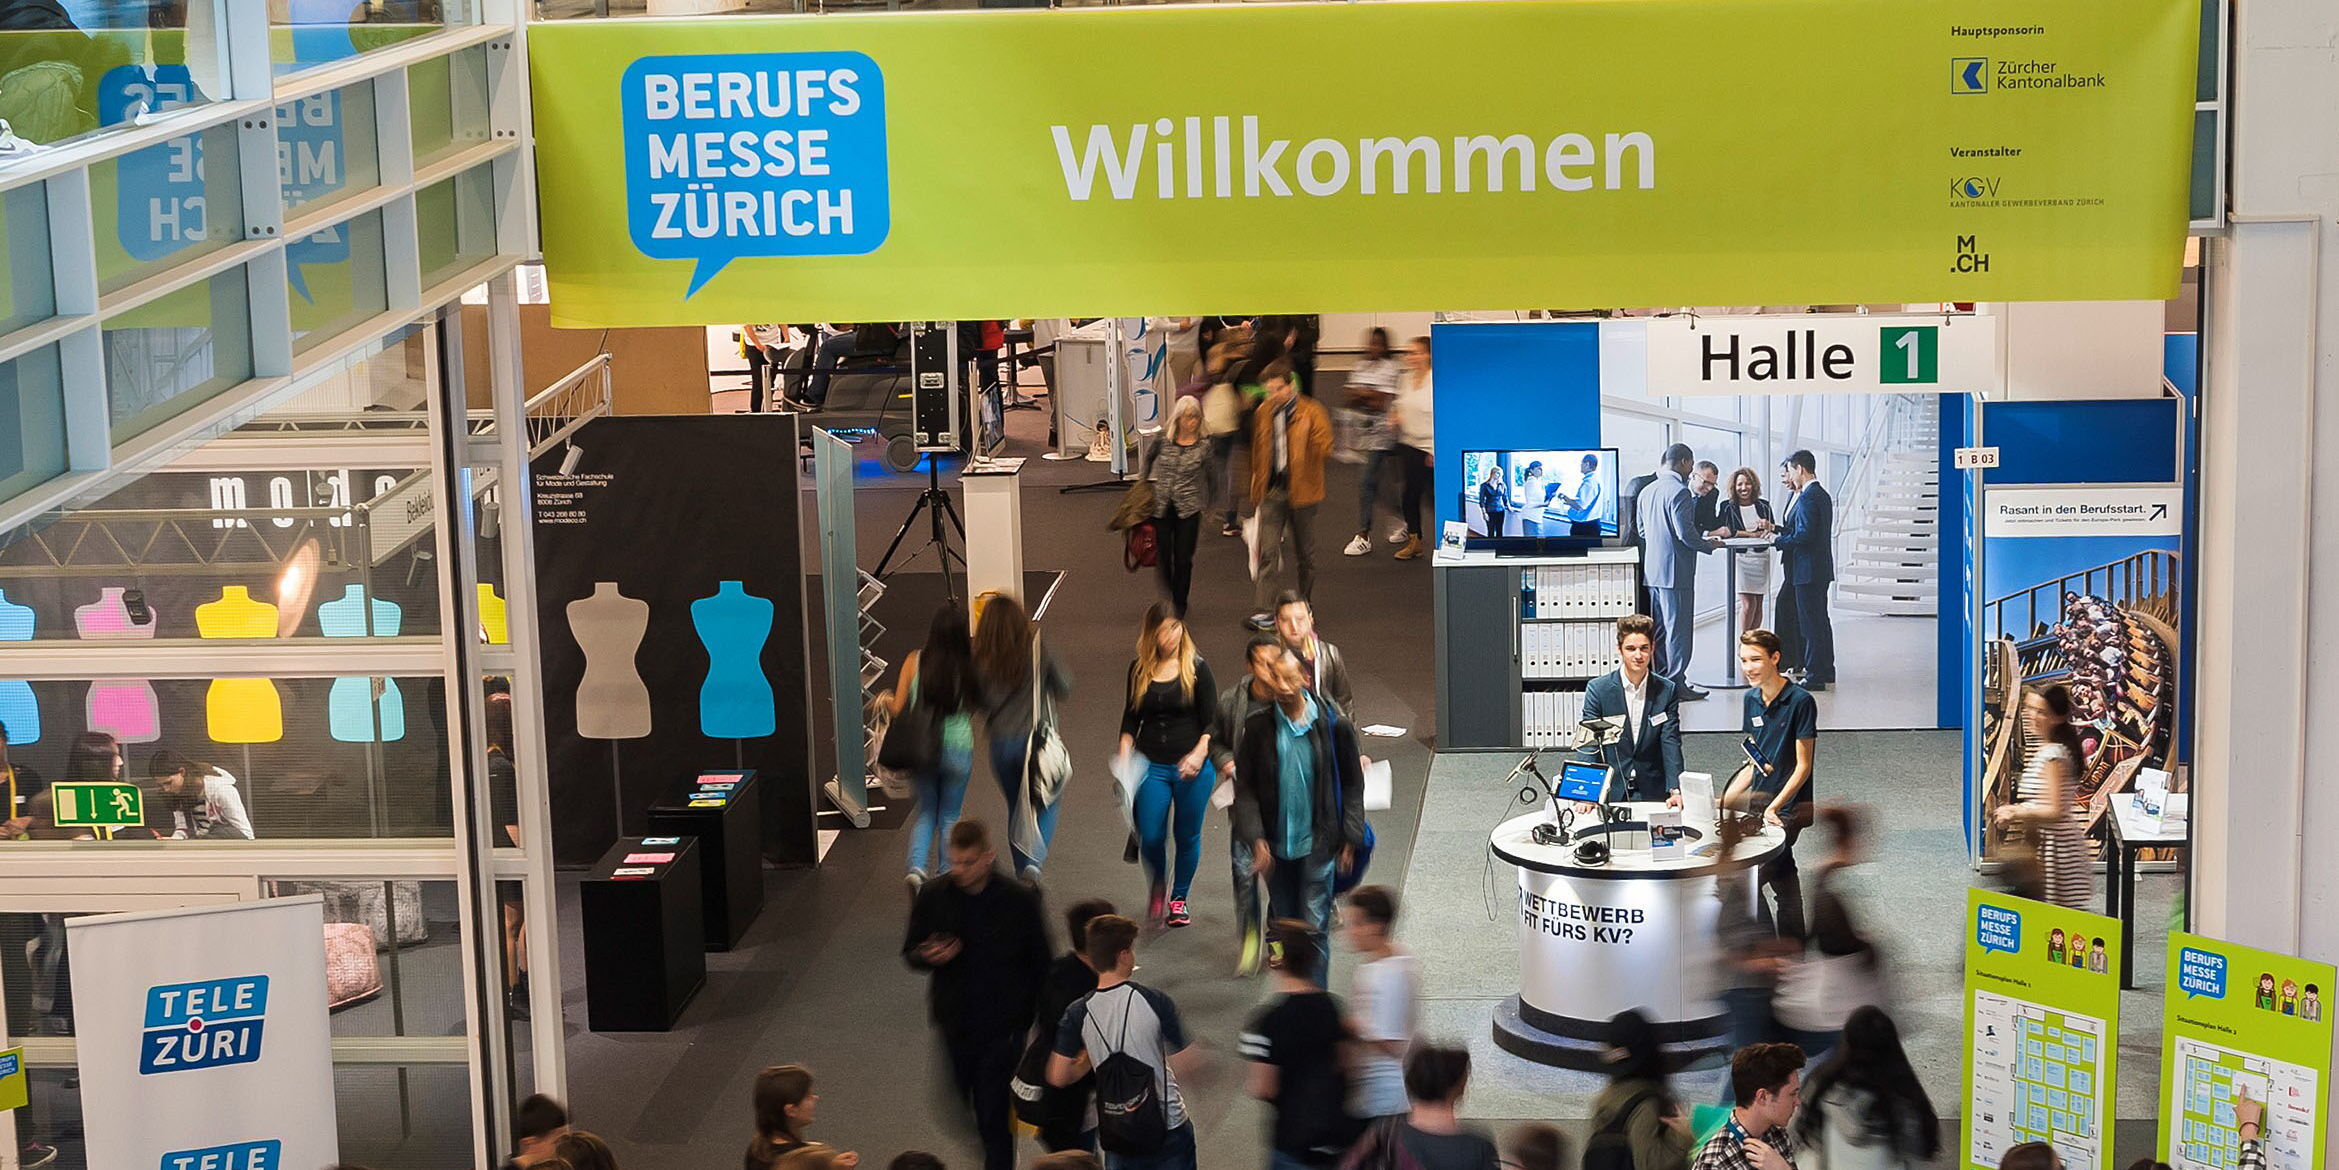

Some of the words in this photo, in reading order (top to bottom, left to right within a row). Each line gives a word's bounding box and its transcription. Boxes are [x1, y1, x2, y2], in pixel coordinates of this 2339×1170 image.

[1951, 25, 2045, 39] Hauptsponsorin
[1997, 60, 2057, 74] Zürcher
[1997, 73, 2105, 89] Kantonalbank
[645, 69, 861, 120] BERUFS
[648, 129, 831, 180] MESSE
[1050, 115, 1656, 201] Willkommen
[1950, 146, 2022, 158] Veranstalter
[1950, 177, 2001, 198] KGV
[651, 183, 854, 239] ZÜRICH
[1950, 200, 1999, 208] KANTONALER
[2002, 199, 2074, 208] GEWERBEVERBAND
[2076, 198, 2105, 206] ZÜRICH
[1957, 235, 1976, 253] M
[1701, 330, 1855, 381] Halle
[1895, 331, 1919, 379] 1
[1958, 455, 1963, 464] 1
[1971, 455, 1978, 464] B
[1981, 454, 1994, 464] 03
[575, 480, 608, 488] Gestaltung
[553, 498, 573, 506] Zürich
[2000, 505, 2039, 515] Rasant
[2042, 505, 2052, 515] in
[2055, 504, 2077, 514] den
[2080, 504, 2147, 514] Berufsstart.
[1524, 891, 1645, 924] WETTBEWERB
[1981, 907, 2018, 925] BERUFS
[1524, 910, 1539, 930] FIT
[1542, 917, 1587, 941] FÜRS
[1593, 927, 1634, 945] KV?
[1980, 921, 2012, 936] MESSE
[1980, 931, 2015, 949] ZÜRICH
[2184, 950, 2223, 969] BERUFS
[2183, 963, 2217, 980] MESSE
[2182, 976, 2220, 994] ZÜRICH
[159, 983, 255, 1018] TELE
